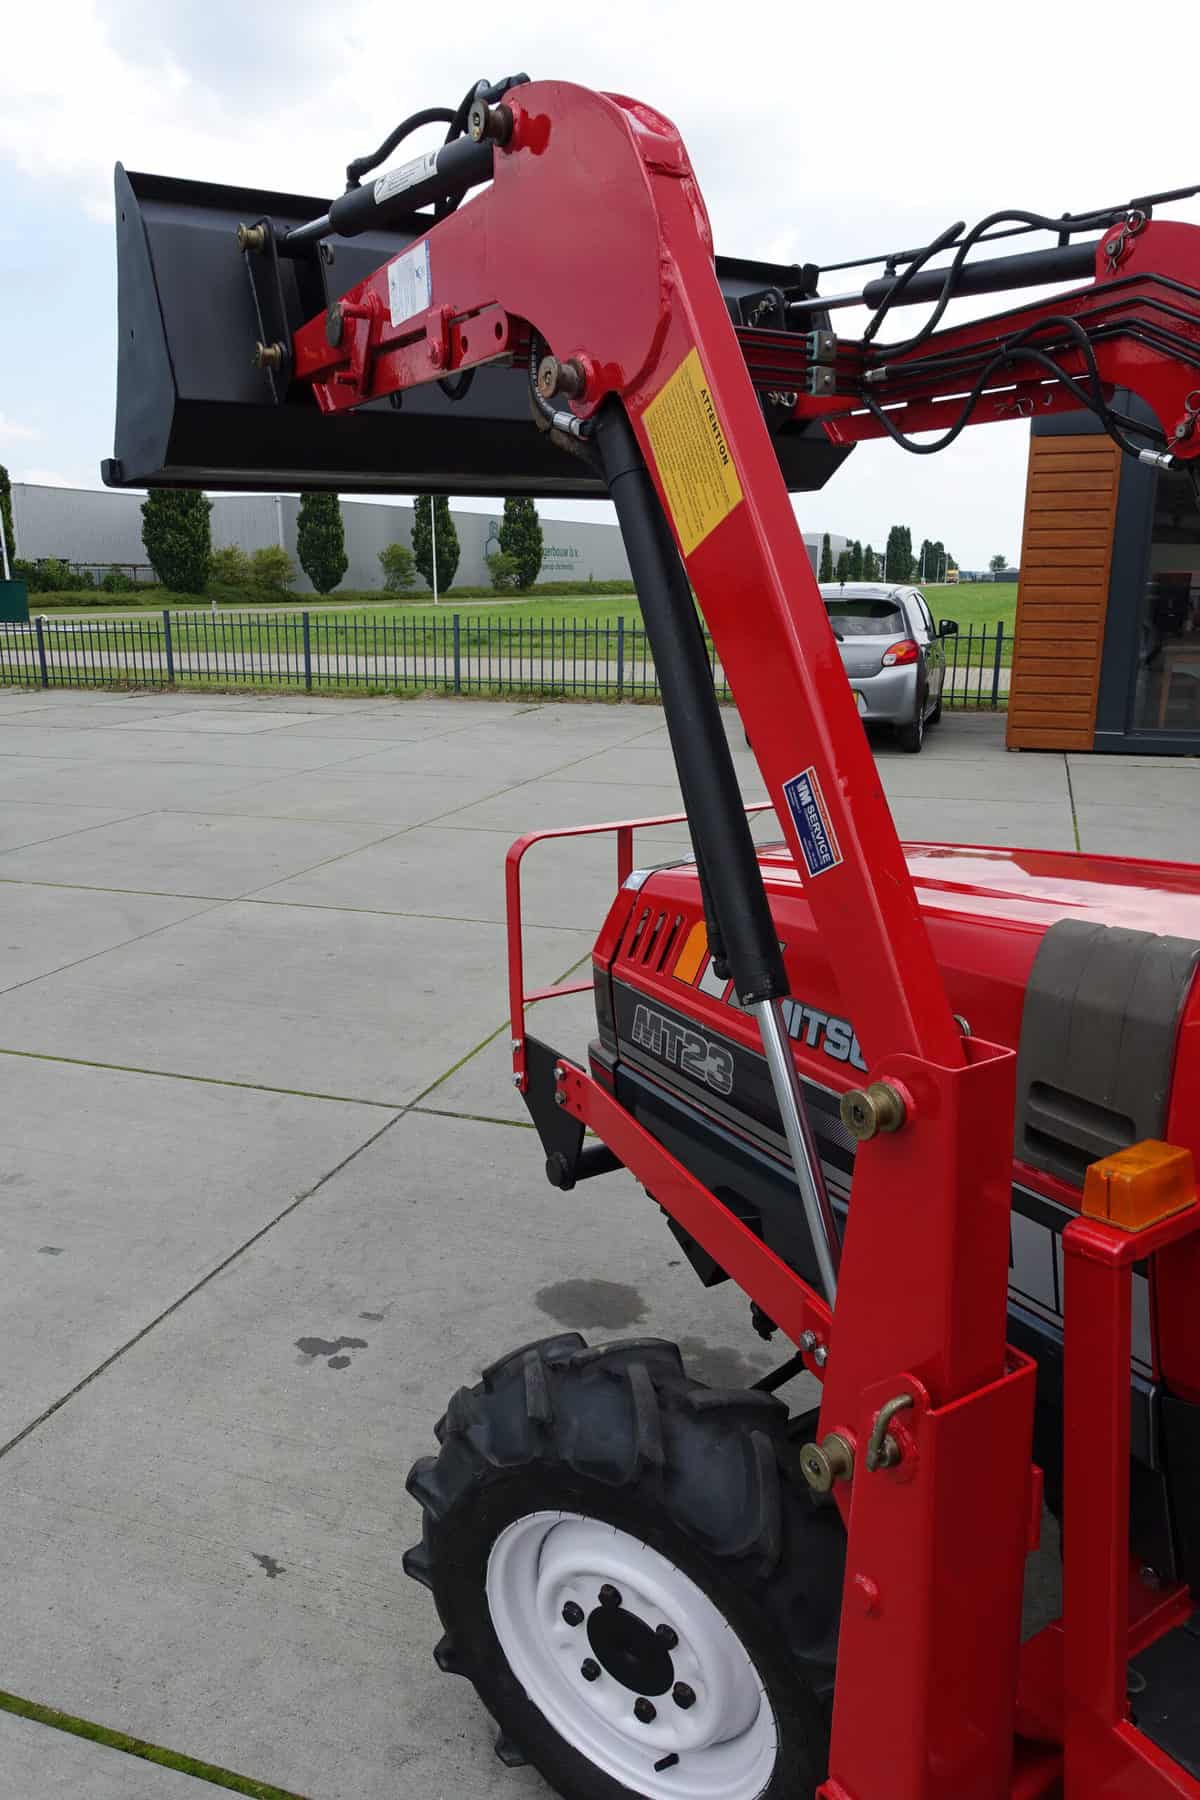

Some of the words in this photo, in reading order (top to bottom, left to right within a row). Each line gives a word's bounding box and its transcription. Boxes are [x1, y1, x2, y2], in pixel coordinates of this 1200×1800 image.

[700, 388, 729, 465] ATTENTION
[807, 804, 831, 863] SERVICE
[631, 1003, 735, 1095] MT23
